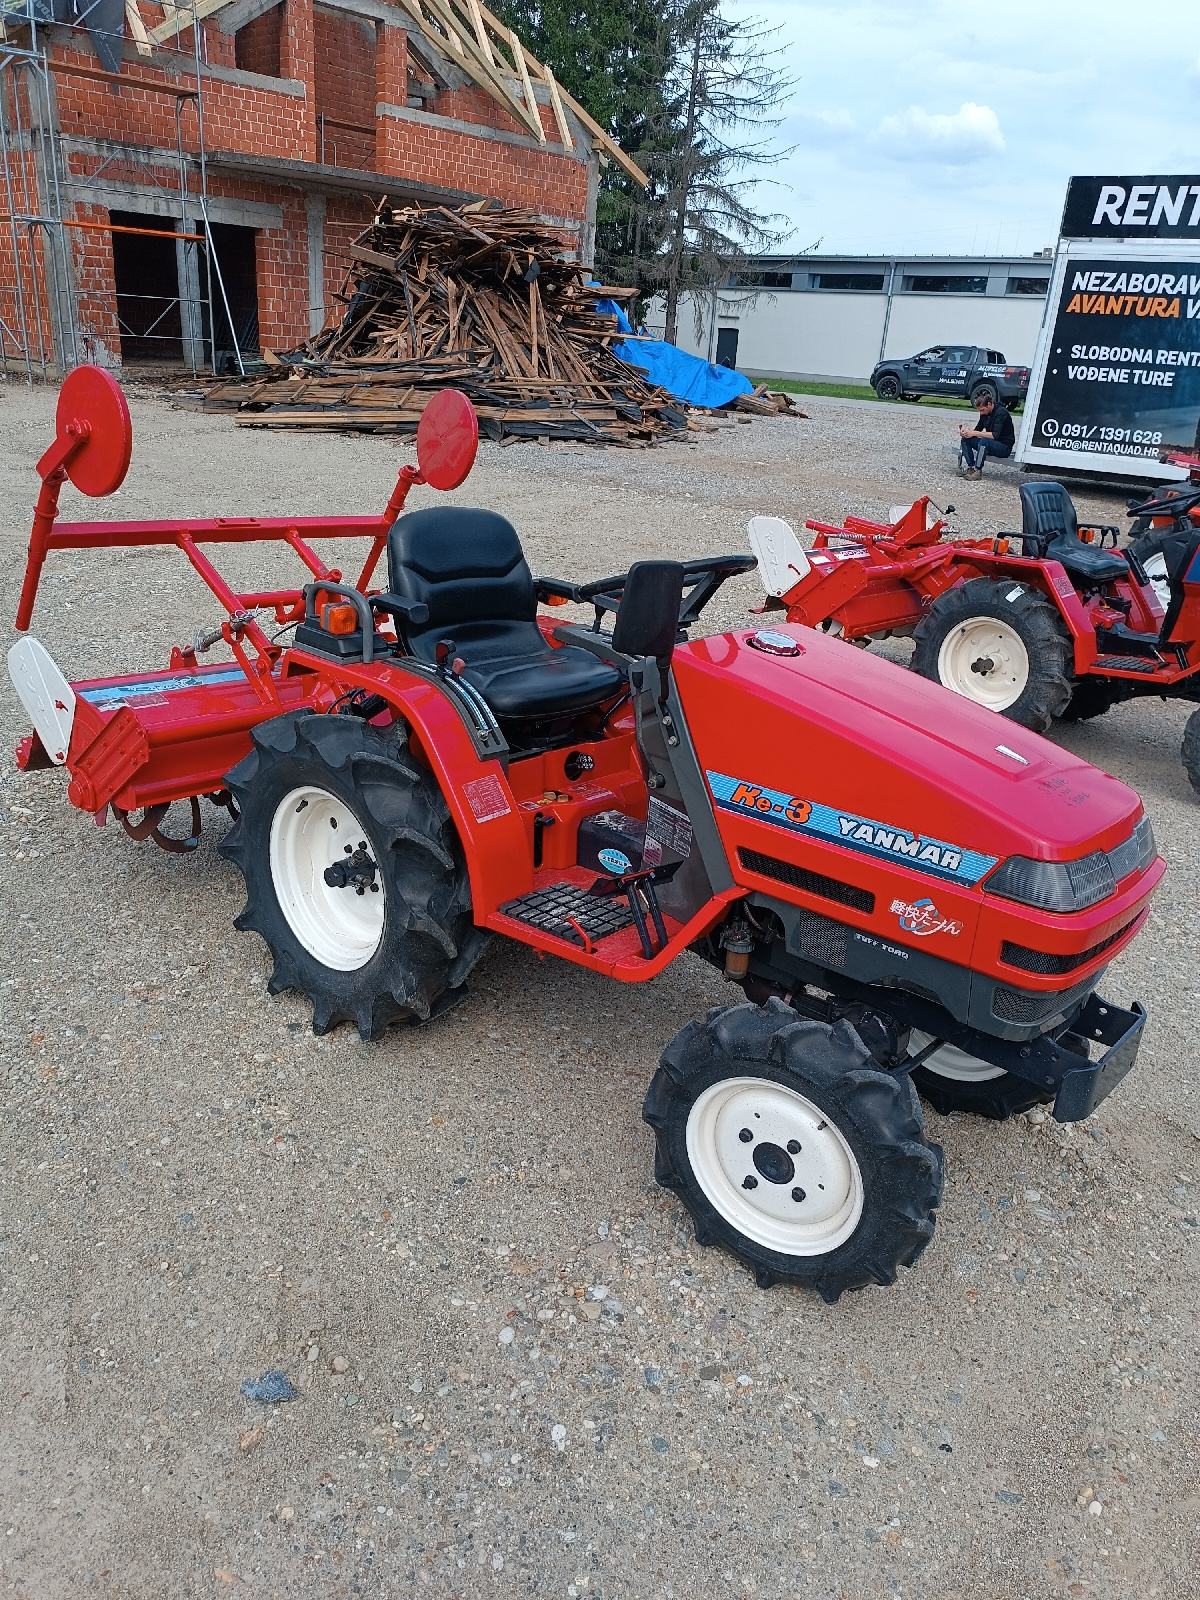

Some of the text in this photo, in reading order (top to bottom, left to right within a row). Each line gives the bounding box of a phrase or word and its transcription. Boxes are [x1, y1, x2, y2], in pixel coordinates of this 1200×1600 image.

[1066, 294, 1180, 318] AVANTURA
[1071, 345, 1200, 367] SLOBODNA RENT
[1068, 365, 1175, 387] VOĐENE TURE
[1061, 423, 1162, 445] 091/ 1391 628
[1049, 437, 1160, 457] INFO@RENTAQUAD.HR
[730, 783, 963, 871] Ke-3 YANMAR
